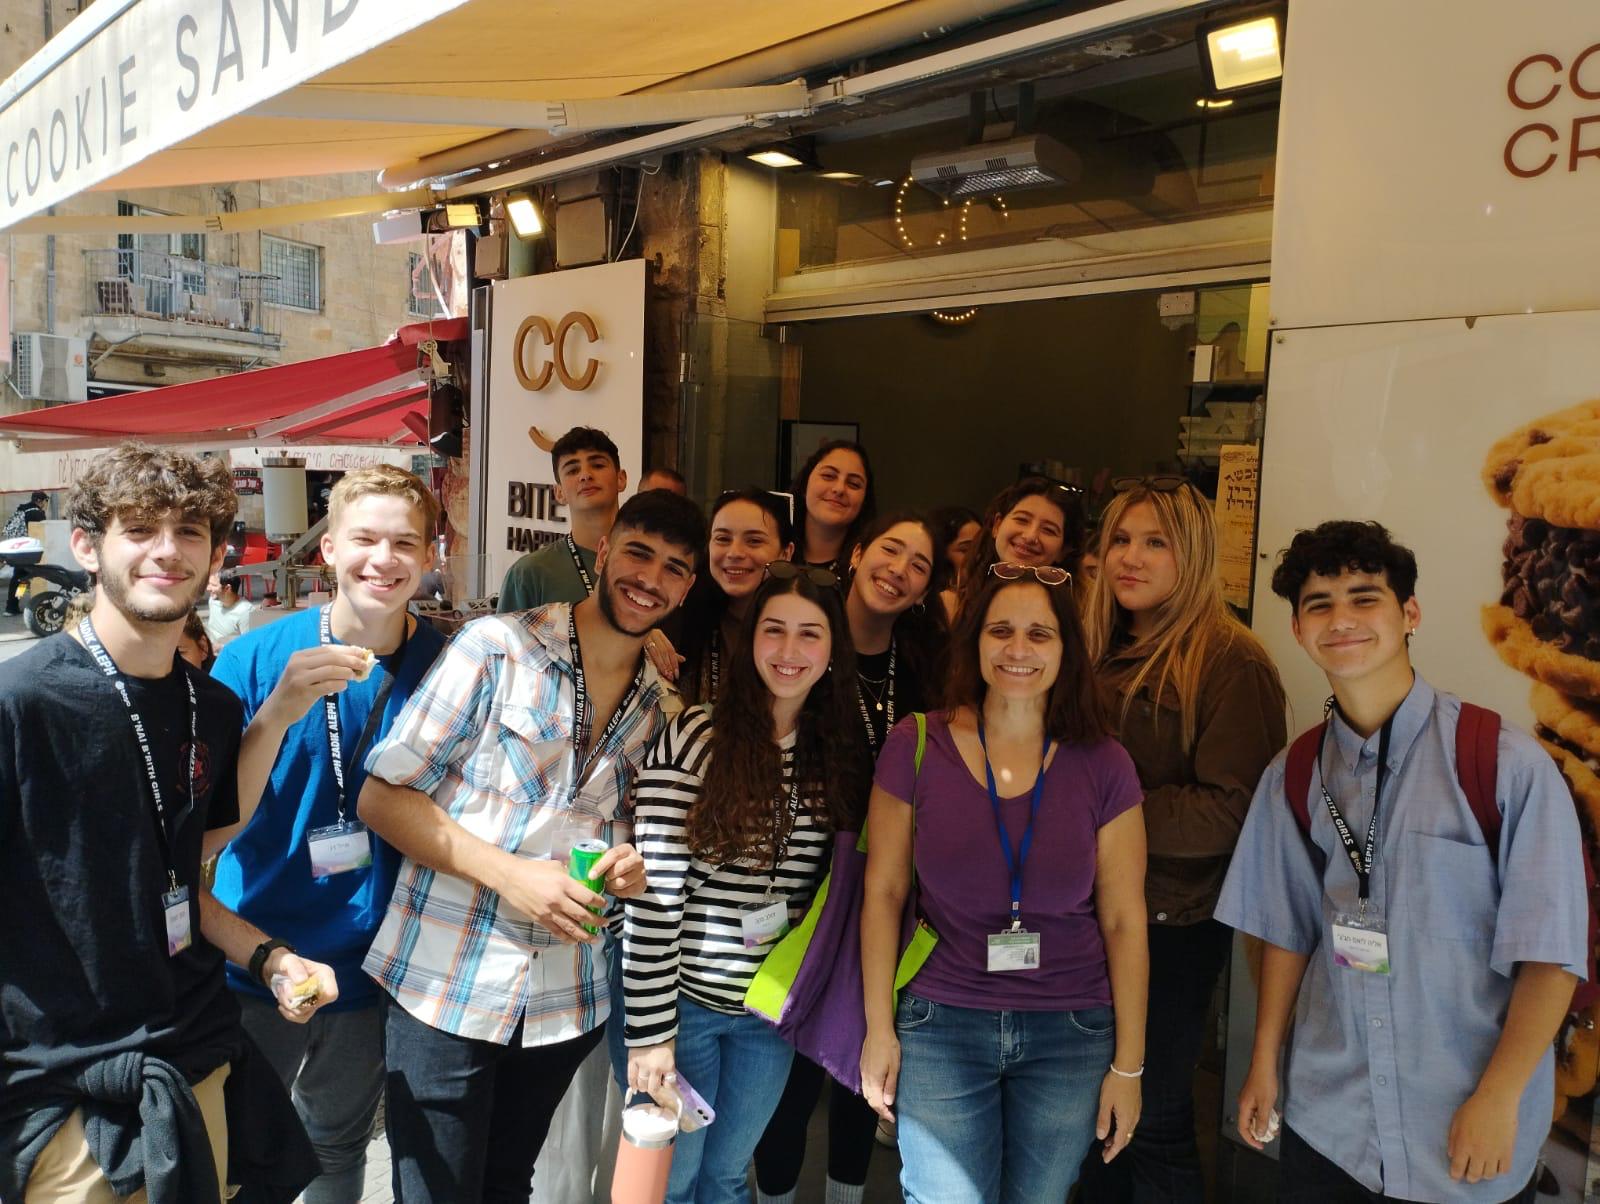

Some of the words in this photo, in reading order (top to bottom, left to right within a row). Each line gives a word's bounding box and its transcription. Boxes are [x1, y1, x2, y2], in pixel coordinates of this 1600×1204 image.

[6, 55, 138, 207] COOKIE
[513, 311, 599, 391] CC
[508, 481, 566, 522] BITE
[89, 645, 116, 676] ALEPH
[575, 668, 584, 691] B'NAI
[326, 702, 336, 731] ALEPH
[576, 693, 585, 723] B'RITH
[607, 709, 622, 736] ALEPH
[328, 731, 341, 761] ZADIK
[131, 713, 147, 743] B'NAI
[142, 744, 156, 781] B'RITH
[151, 781, 164, 812] GIRLS
[331, 761, 344, 788] ALEPH
[1335, 818, 1354, 845] GIRLS
[1367, 816, 1376, 840] ZAD
[1365, 843, 1374, 874] ALEPH
